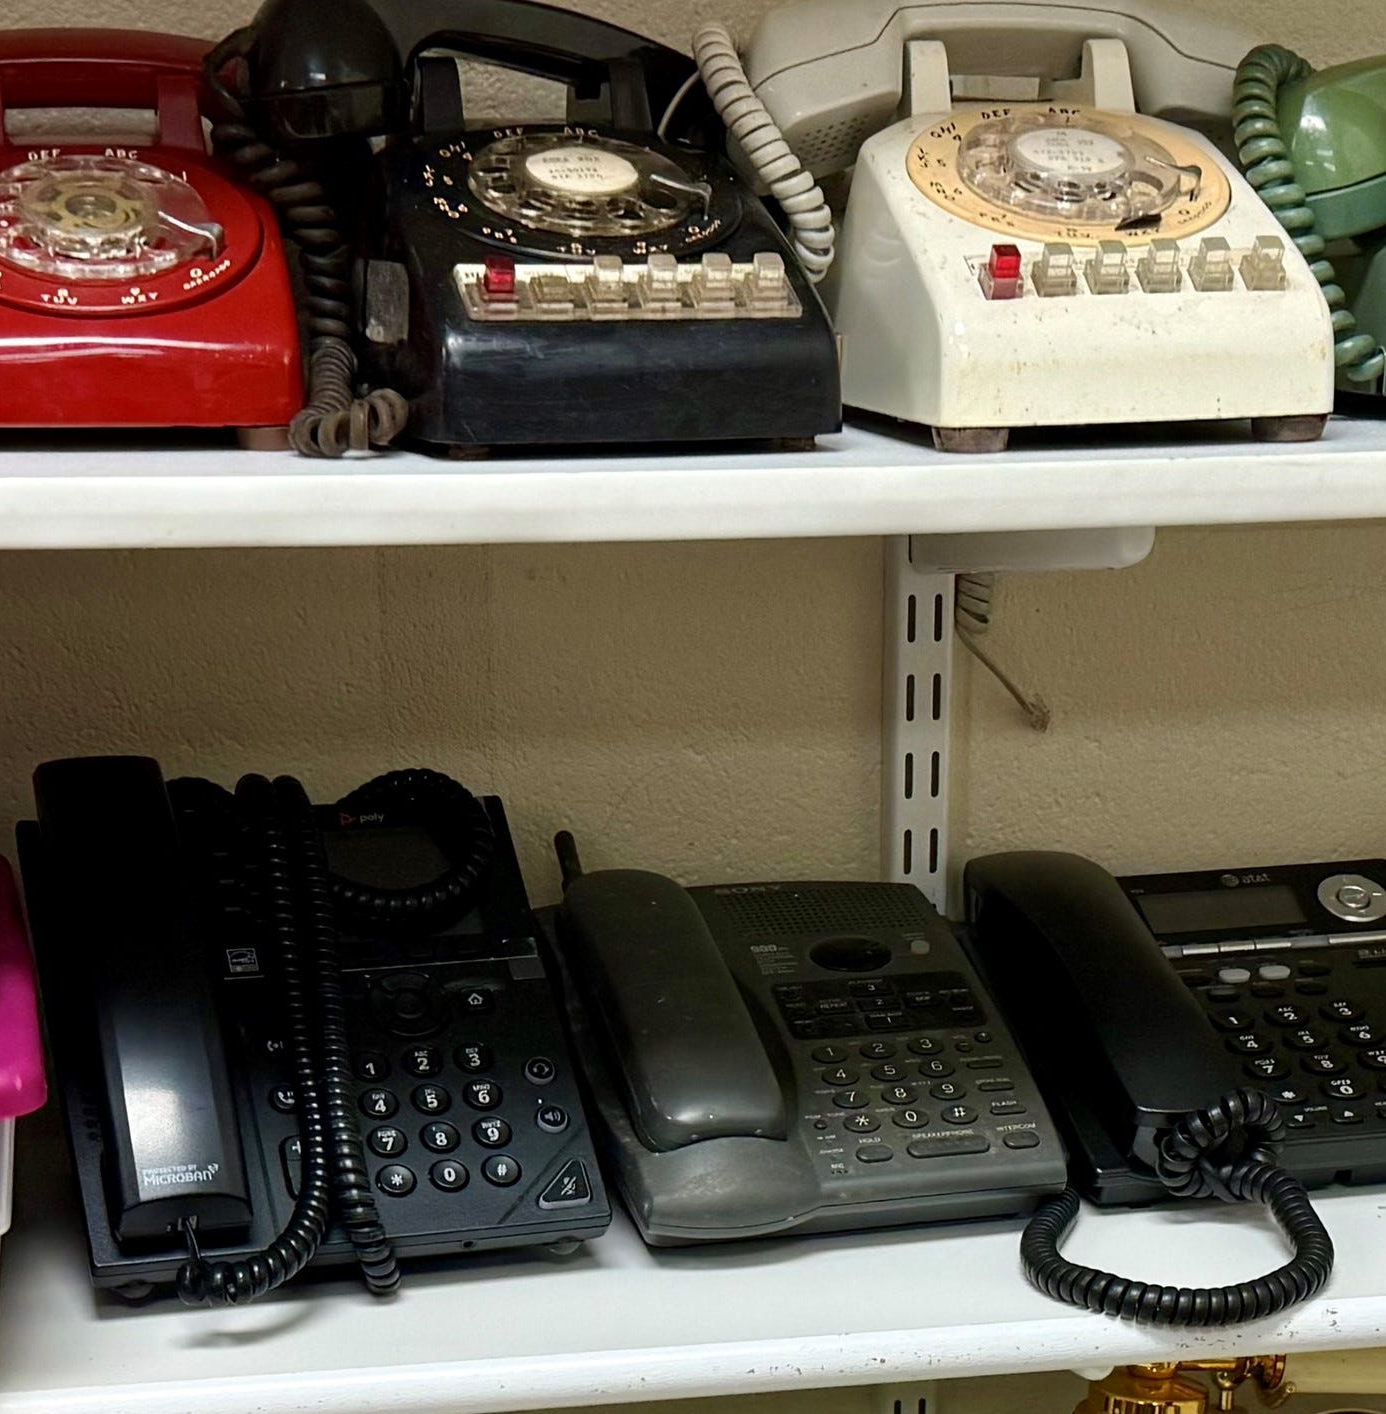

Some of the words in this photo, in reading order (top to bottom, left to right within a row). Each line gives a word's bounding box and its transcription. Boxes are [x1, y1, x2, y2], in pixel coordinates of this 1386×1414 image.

[563, 126, 599, 138] ABC
[27, 148, 61, 161] DEF
[104, 148, 138, 160] ABC
[359, 813, 384, 824] poly
[872, 1043, 884, 1053] 2
[919, 1038, 932, 1049] 3
[417, 1057, 429, 1070] 2
[470, 1054, 481, 1067] 3
[931, 1060, 943, 1071] 6
[366, 1063, 376, 1075] 1
[835, 1068, 847, 1079] 4
[884, 1065, 896, 1075] 5
[894, 1087, 906, 1098] 8
[942, 1083, 954, 1094] 9
[426, 1094, 438, 1108] 5
[477, 1090, 490, 1103] 6
[846, 1091, 856, 1102] 7
[374, 1100, 386, 1113] 4
[905, 1111, 917, 1122] 0
[435, 1132, 447, 1145] 8
[487, 1127, 499, 1141] 9
[381, 1137, 394, 1150] 7
[443, 1167, 456, 1182] 0
